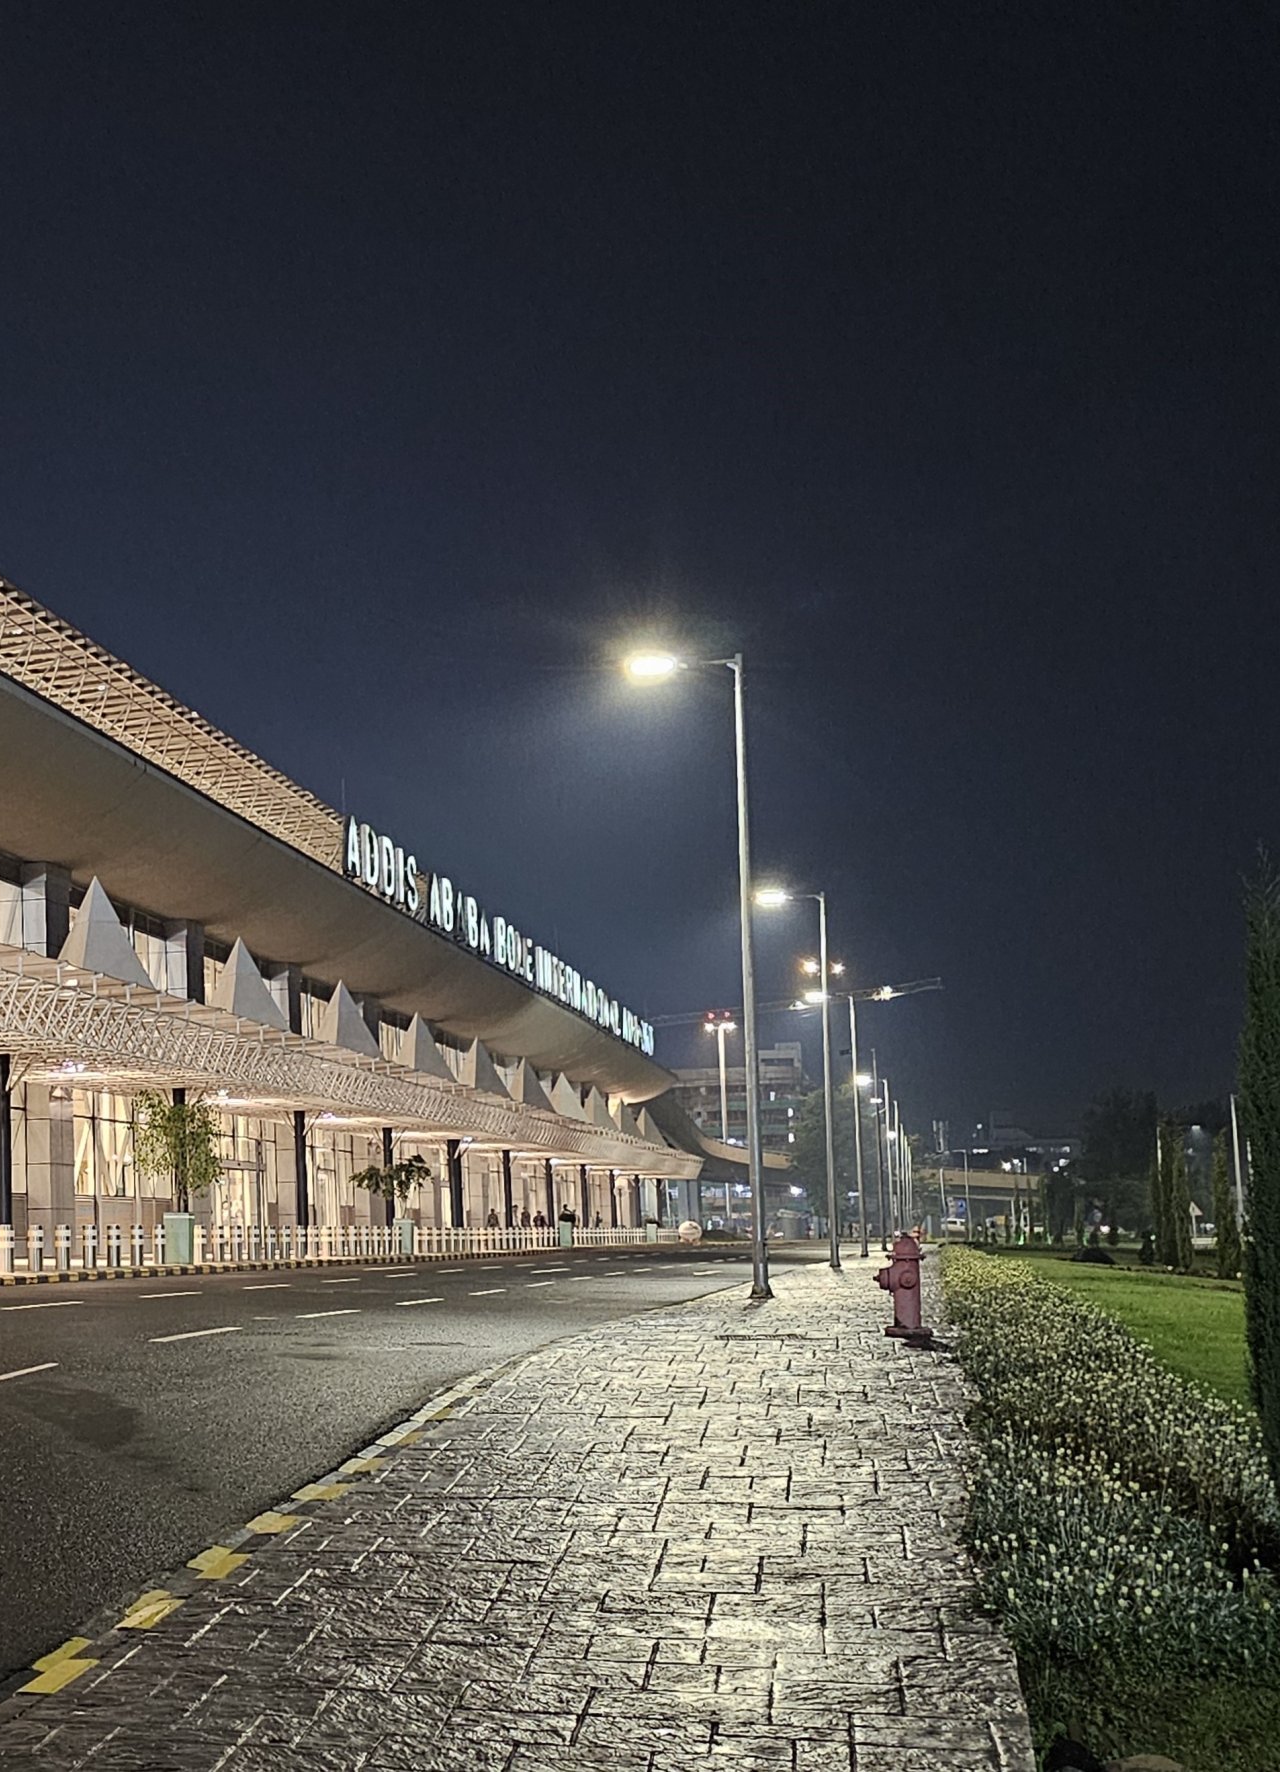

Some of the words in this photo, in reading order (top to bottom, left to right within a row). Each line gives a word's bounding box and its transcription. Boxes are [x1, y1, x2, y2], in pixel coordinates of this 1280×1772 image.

[347, 815, 419, 911] ADDIS
[429, 872, 490, 955] ABABA
[493, 916, 533, 982] BOLE
